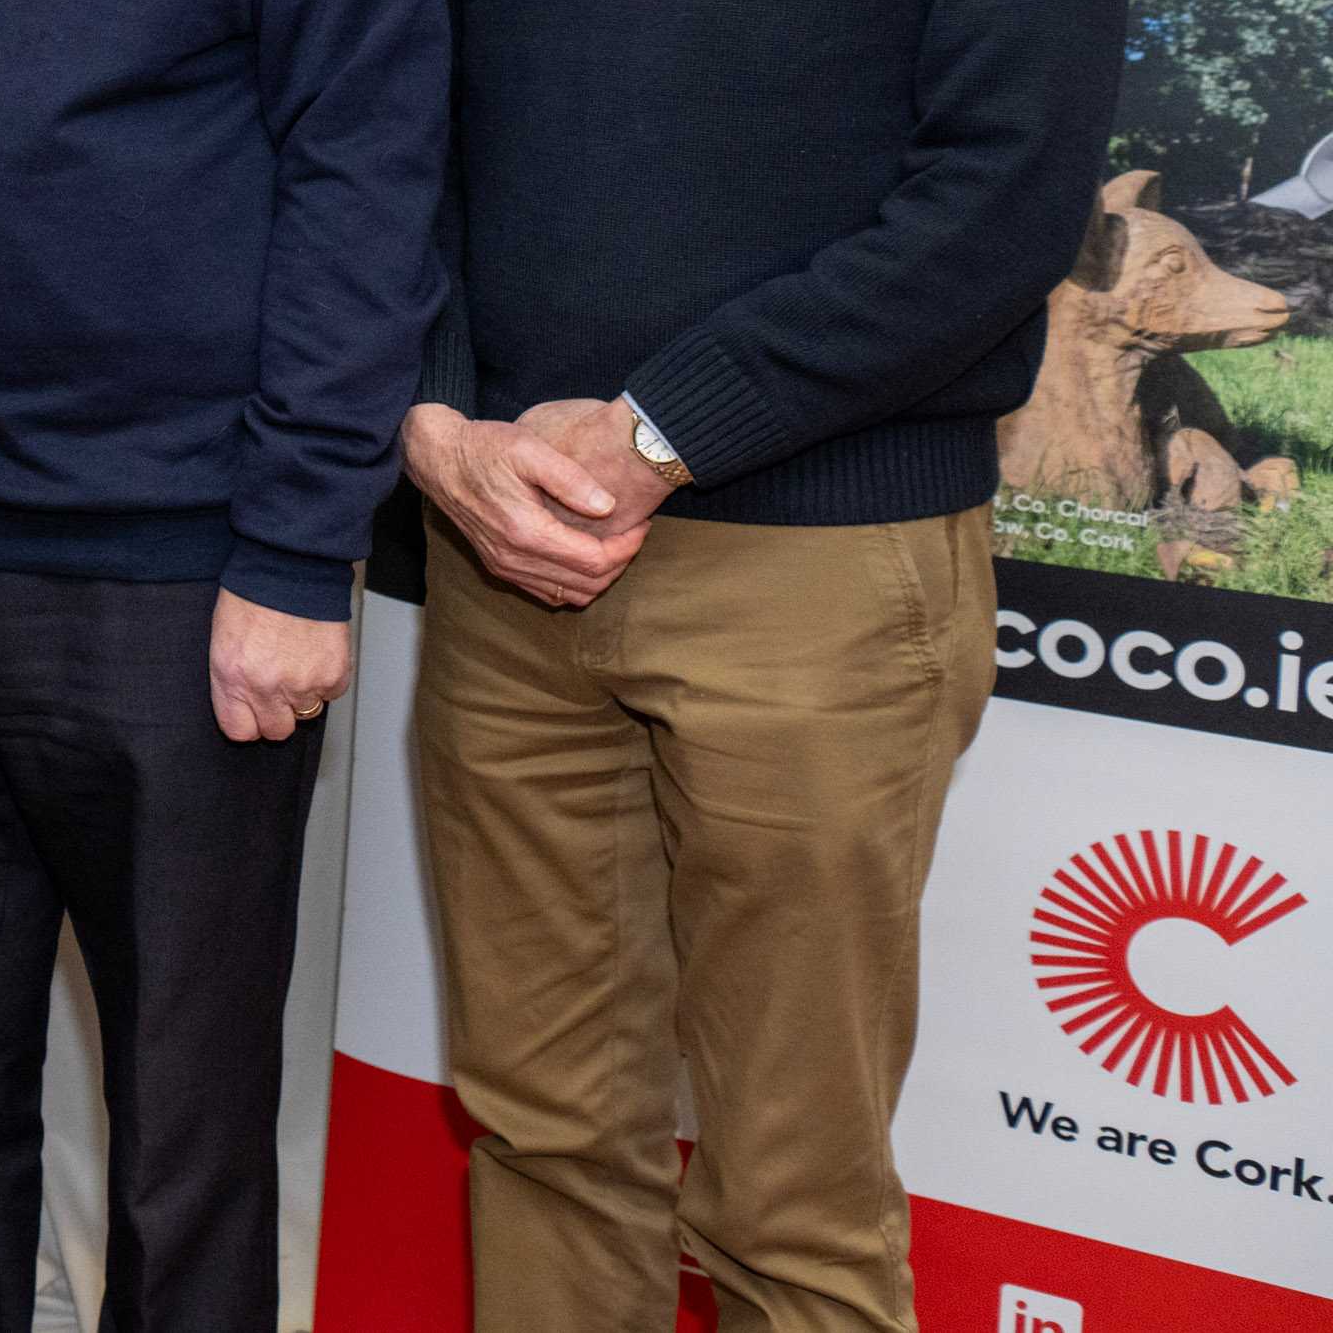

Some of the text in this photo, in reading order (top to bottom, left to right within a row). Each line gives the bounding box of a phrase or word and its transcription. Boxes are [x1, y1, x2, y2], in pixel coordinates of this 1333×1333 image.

[1013, 494, 1051, 514] Co.
[1034, 522, 1074, 543] Co.
[1080, 528, 1135, 551] Cork
[998, 1089, 1080, 1143] We
[1096, 1122, 1177, 1166] are
